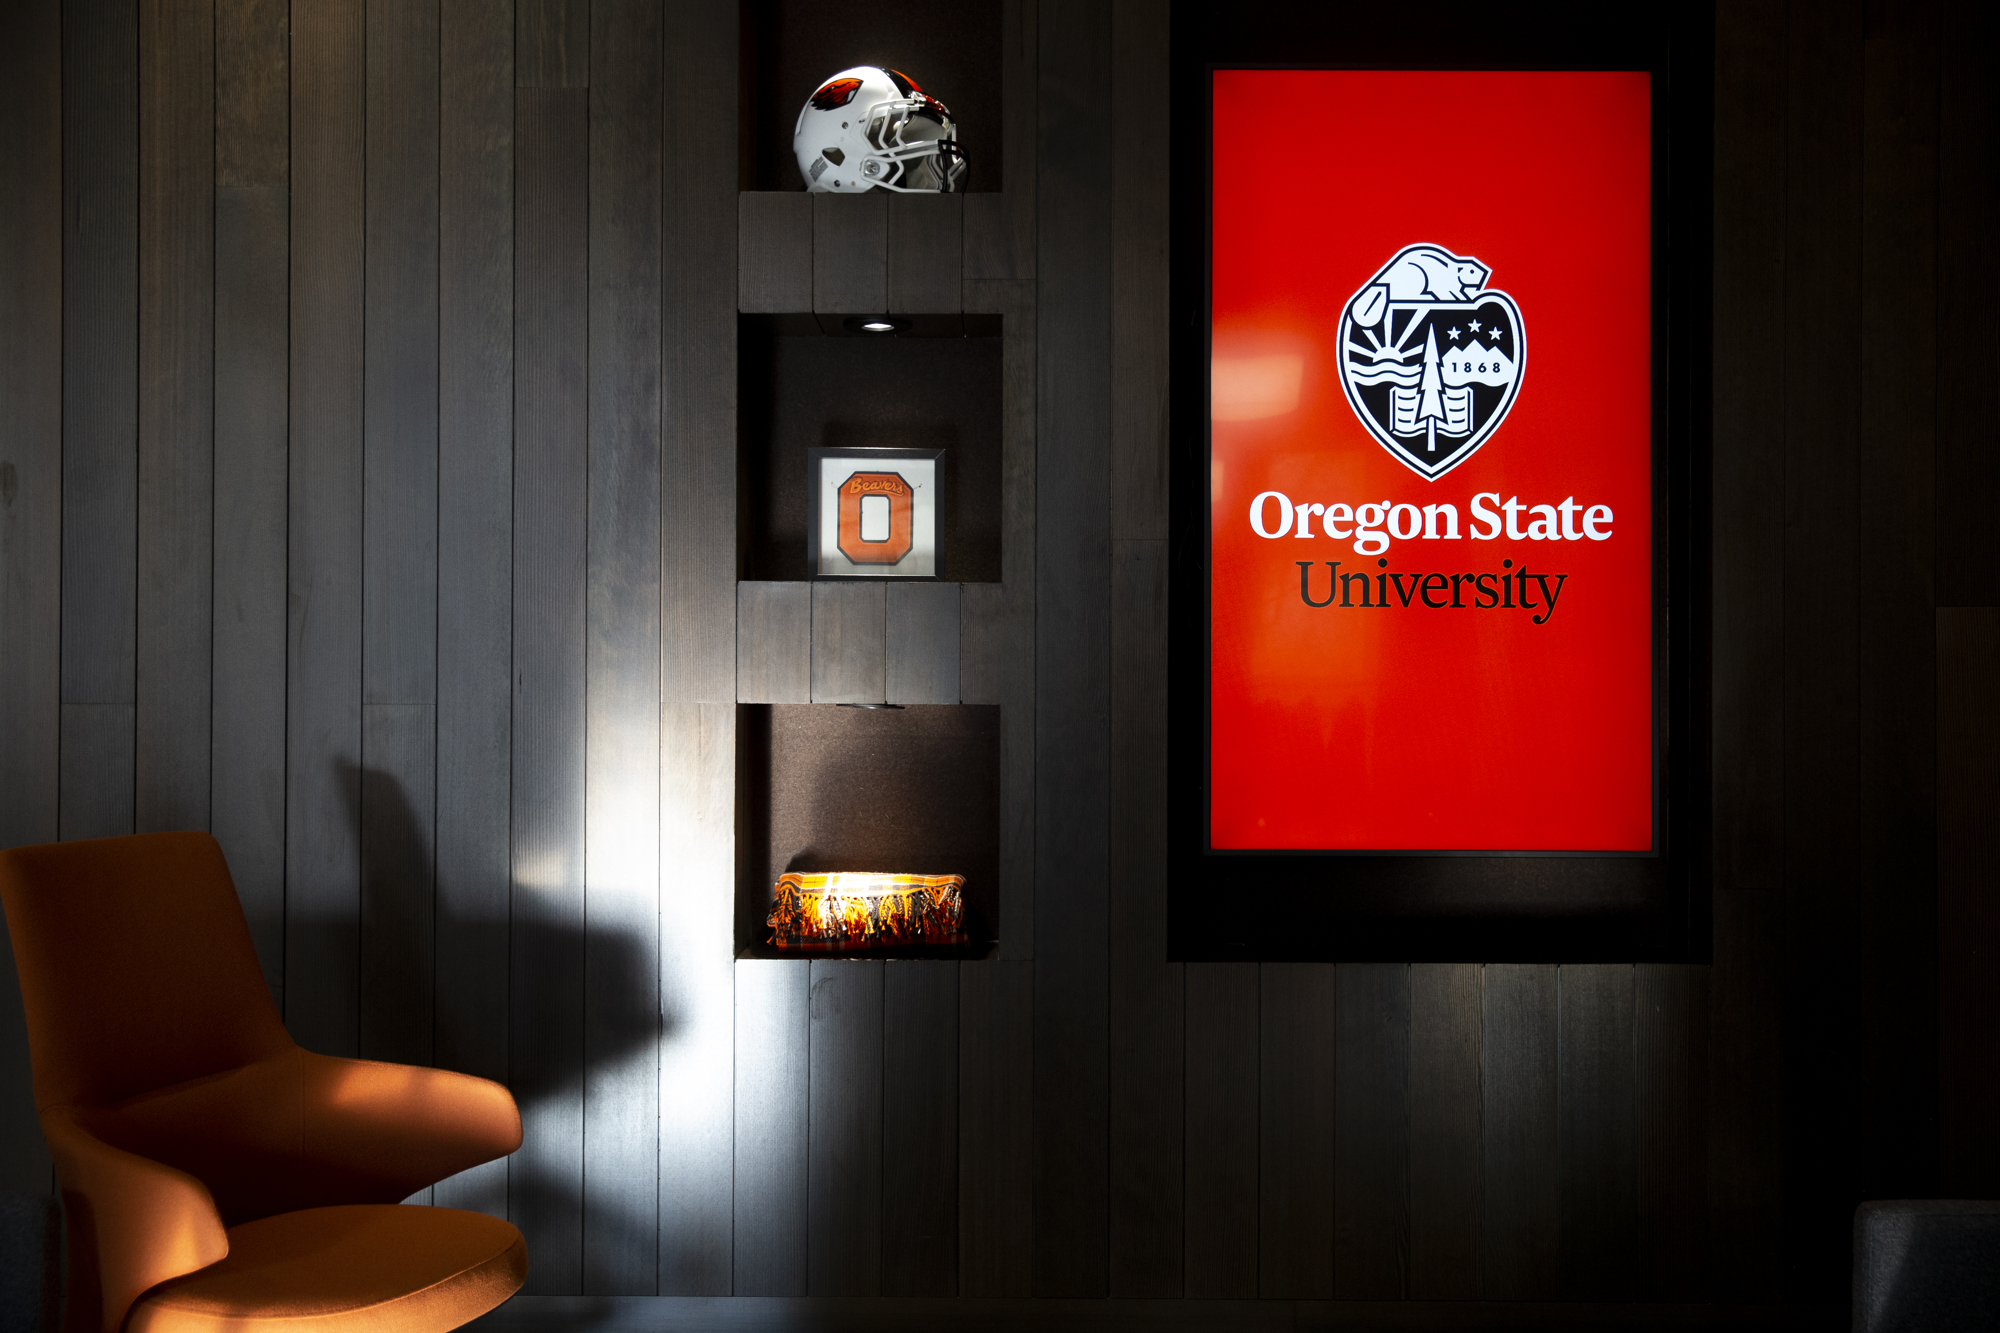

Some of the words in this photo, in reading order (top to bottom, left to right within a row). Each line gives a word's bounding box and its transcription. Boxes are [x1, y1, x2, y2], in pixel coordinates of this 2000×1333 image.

[1452, 362, 1501, 373] 1868
[850, 476, 904, 495] Beavers
[1249, 491, 1462, 555] Oregon
[1470, 492, 1613, 540] State
[1295, 558, 1568, 625] University
